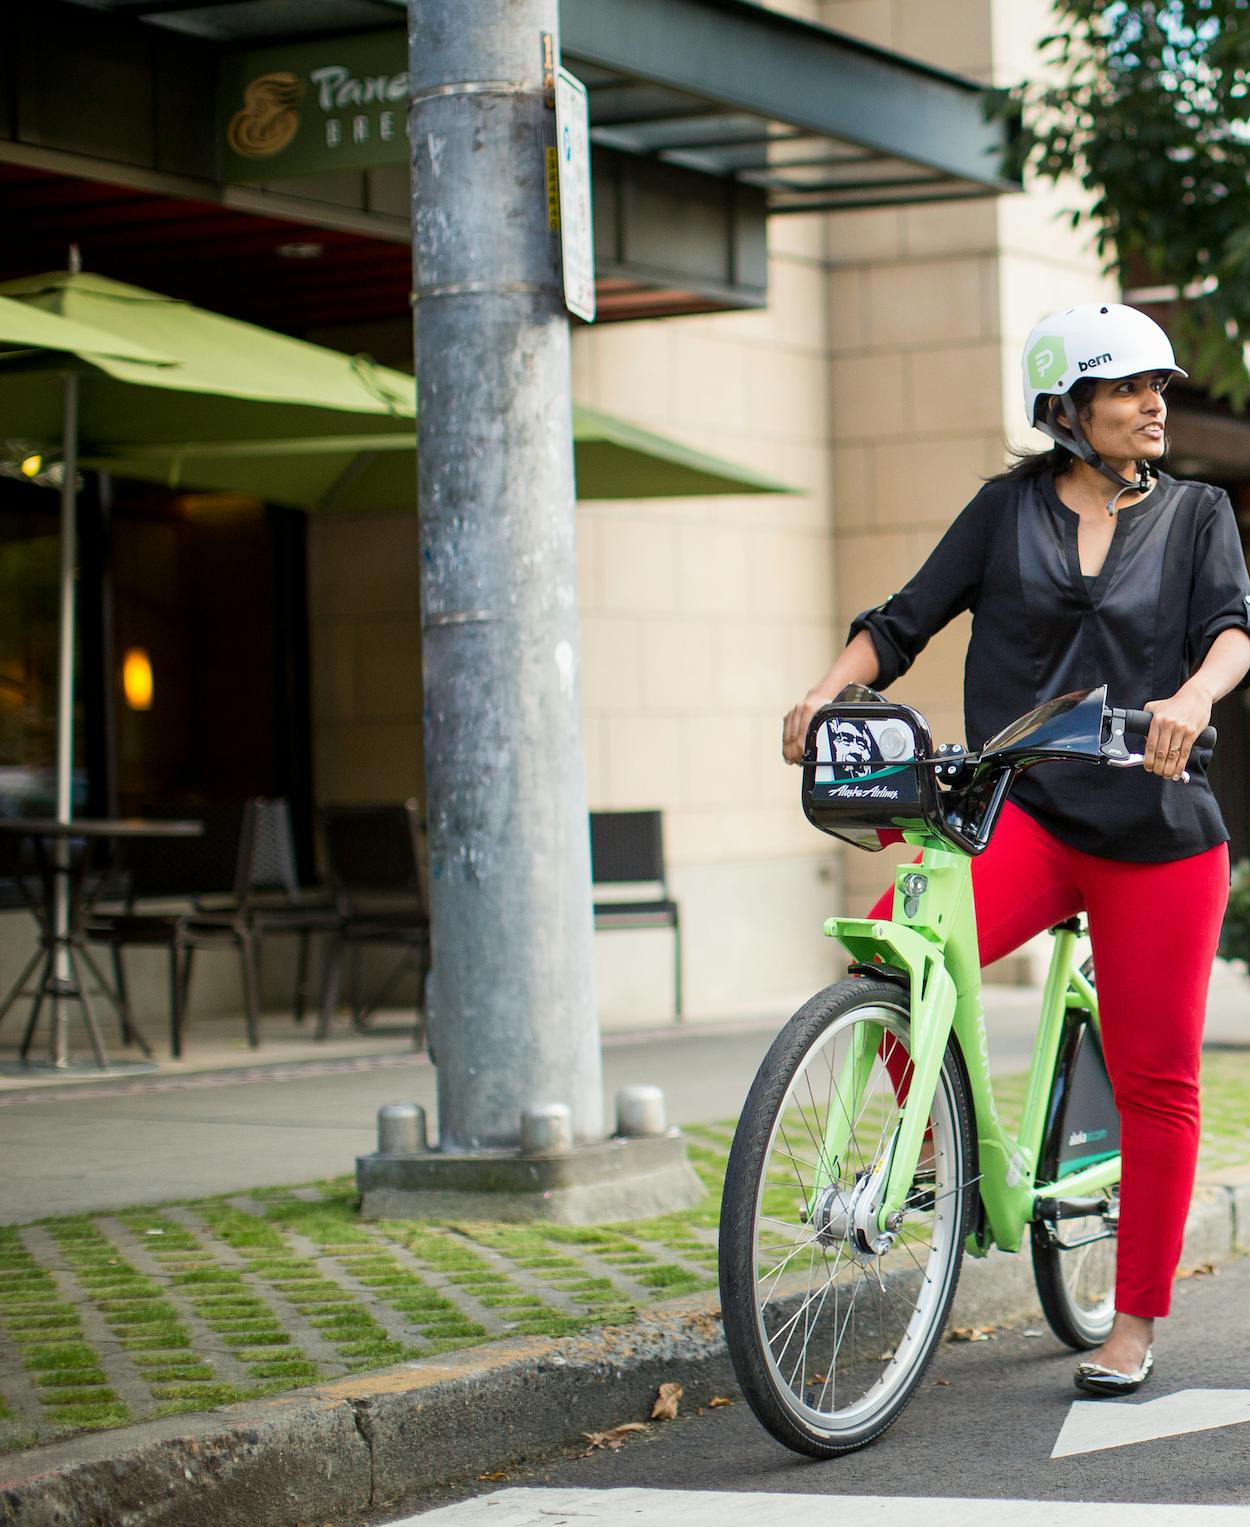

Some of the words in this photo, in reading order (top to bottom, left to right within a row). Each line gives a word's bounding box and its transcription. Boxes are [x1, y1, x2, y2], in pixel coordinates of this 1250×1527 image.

[310, 65, 410, 113] Pane
[325, 111, 411, 148] BRE
[1078, 352, 1112, 372] bern
[828, 784, 862, 798] Alaska
[862, 784, 898, 799] Airlines
